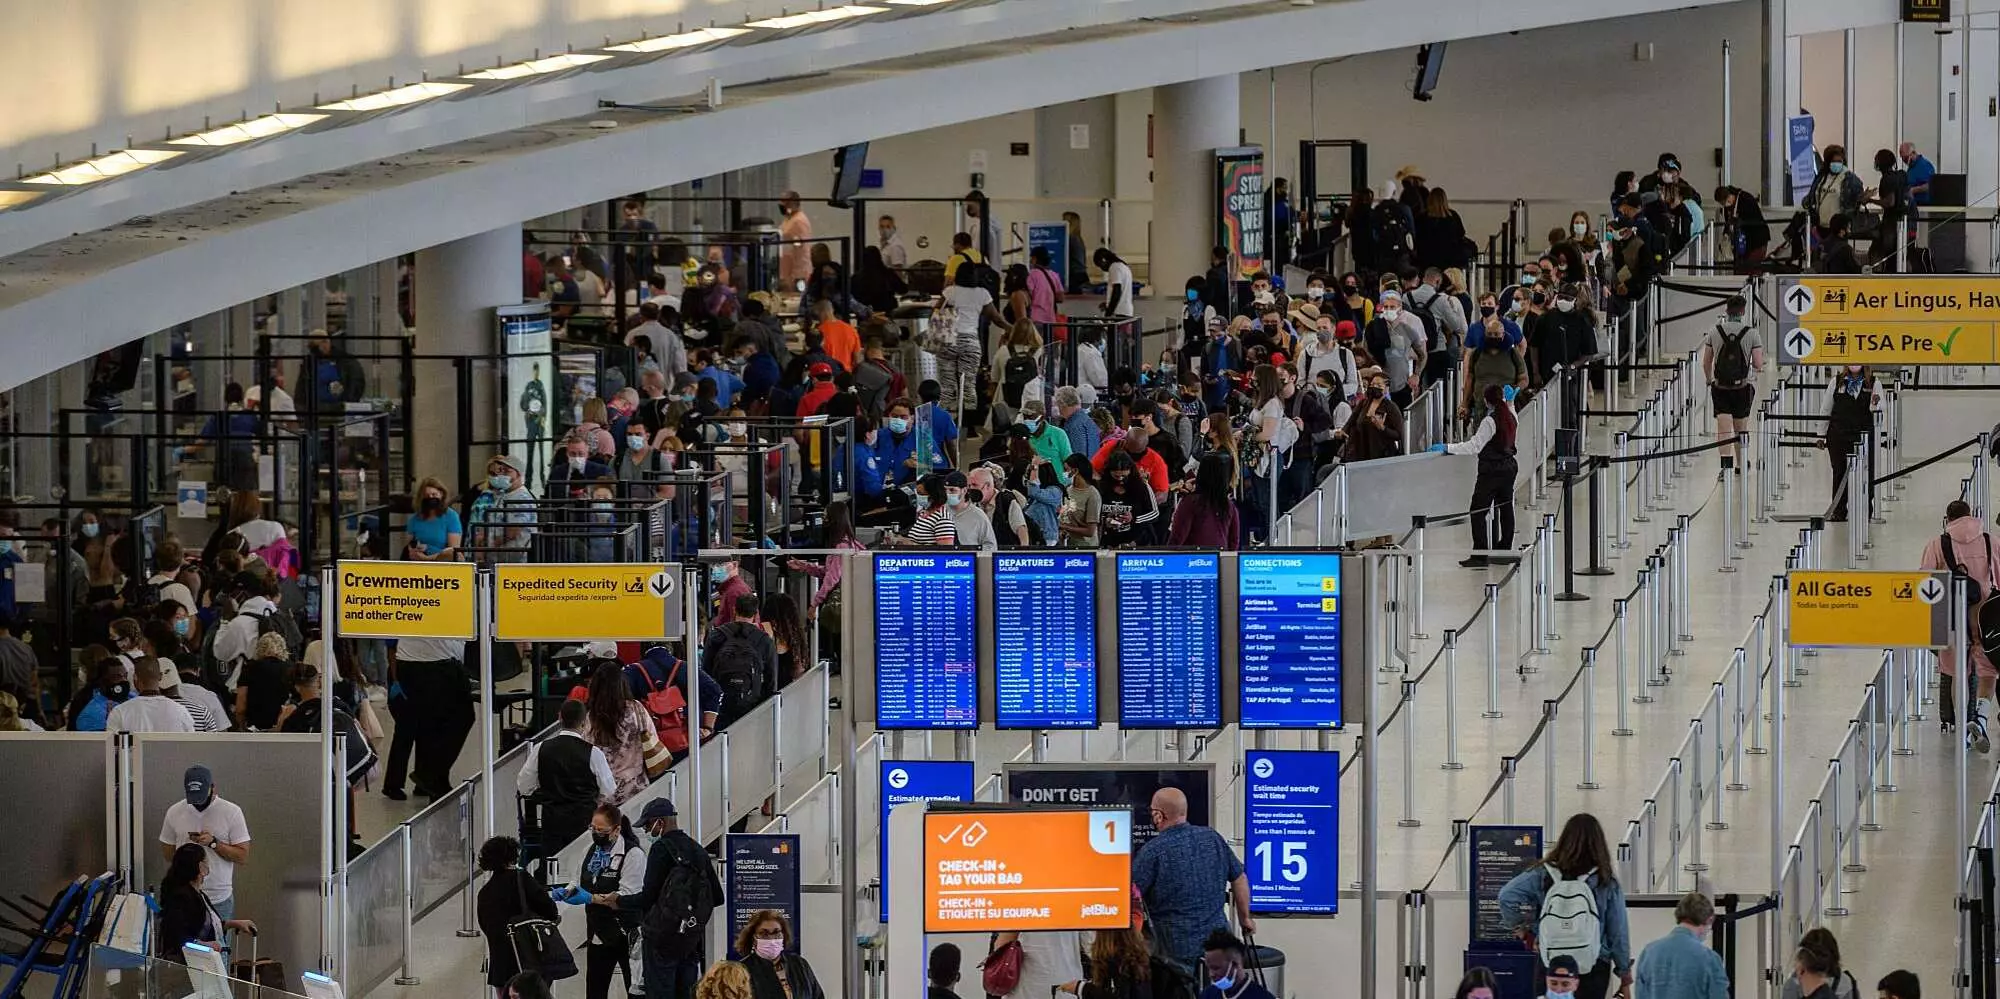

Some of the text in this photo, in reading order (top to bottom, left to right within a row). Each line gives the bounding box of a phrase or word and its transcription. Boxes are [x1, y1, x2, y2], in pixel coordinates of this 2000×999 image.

[1853, 292, 1888, 308] Aer
[1894, 291, 1962, 312] Lingus,
[1855, 335, 1932, 351] TSA Pre
[945, 559, 970, 568] jetBlue
[1065, 559, 1090, 568] jetBlue
[1188, 559, 1213, 567] jetBlue
[345, 573, 460, 590] Crewmembers
[503, 578, 618, 591] Expedited Security
[1797, 581, 1872, 596] All Gates
[345, 595, 440, 608] Airport Employees
[345, 610, 423, 620] and other Crew
[1023, 789, 1099, 801] DON'T GET
[1104, 820, 1116, 842] 1
[938, 860, 996, 872] CHECK-IN
[1255, 841, 1308, 882] 15
[939, 872, 1023, 886] TAG YOUR BAG
[938, 898, 986, 908] CHECK-IN
[938, 908, 1050, 919] ETIQUETE SU EQUIPAJE
[1081, 904, 1119, 919] jetBlue
